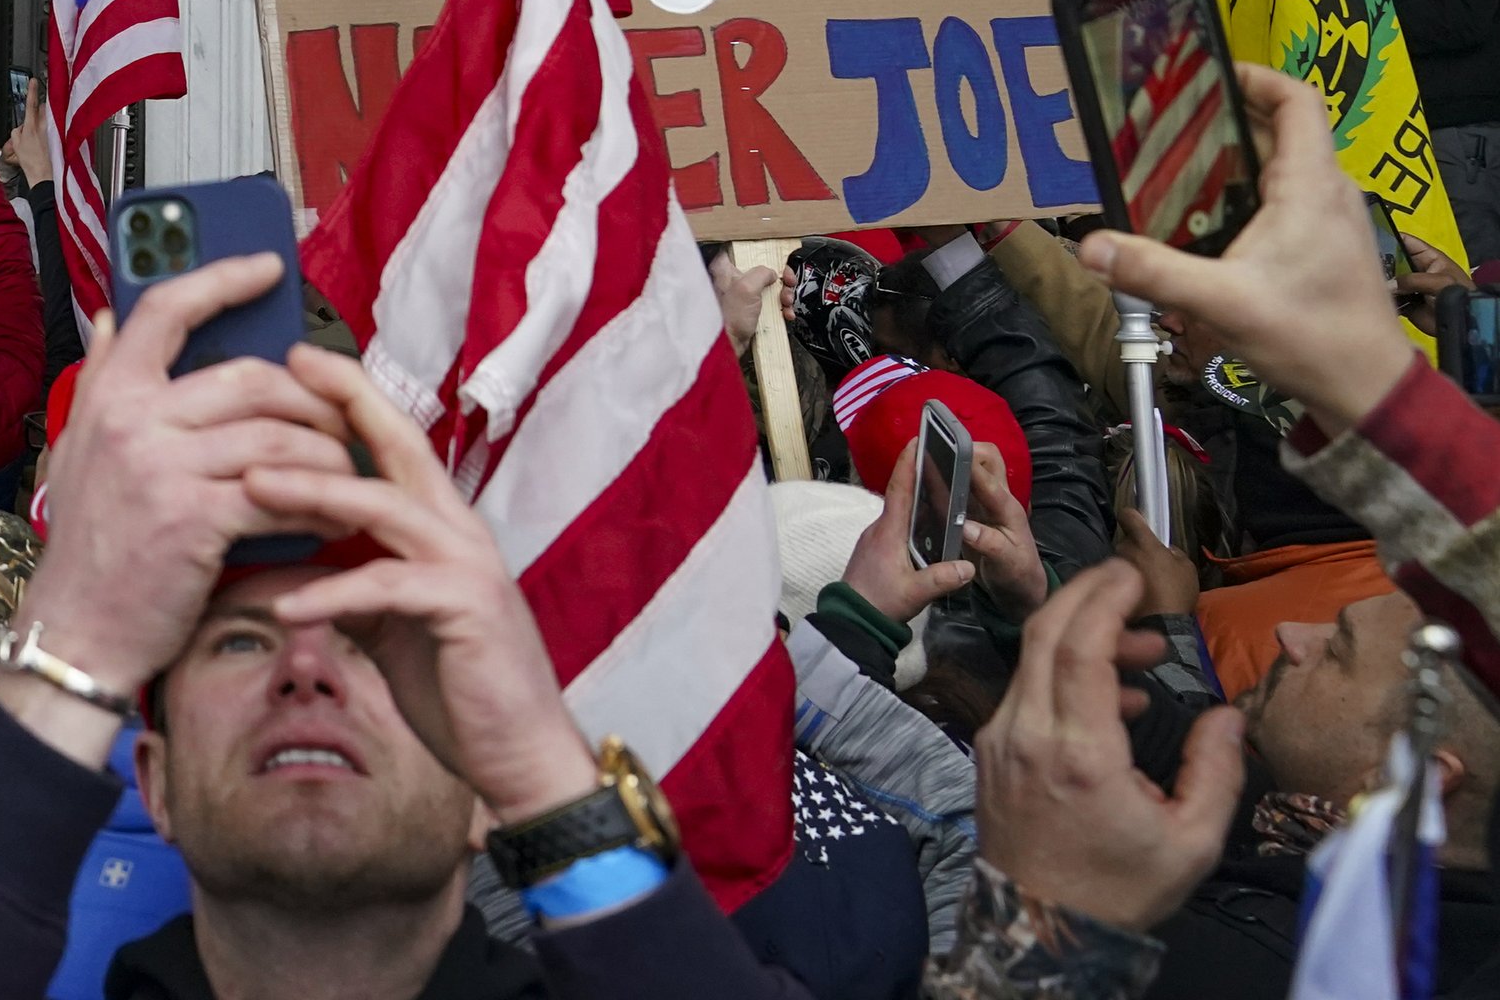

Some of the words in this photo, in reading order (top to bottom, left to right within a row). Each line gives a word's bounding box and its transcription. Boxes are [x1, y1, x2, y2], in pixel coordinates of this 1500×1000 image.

[286, 17, 839, 208] NER
[826, 14, 1101, 224] JOE
[1204, 373, 1250, 407] PRESIDENT
